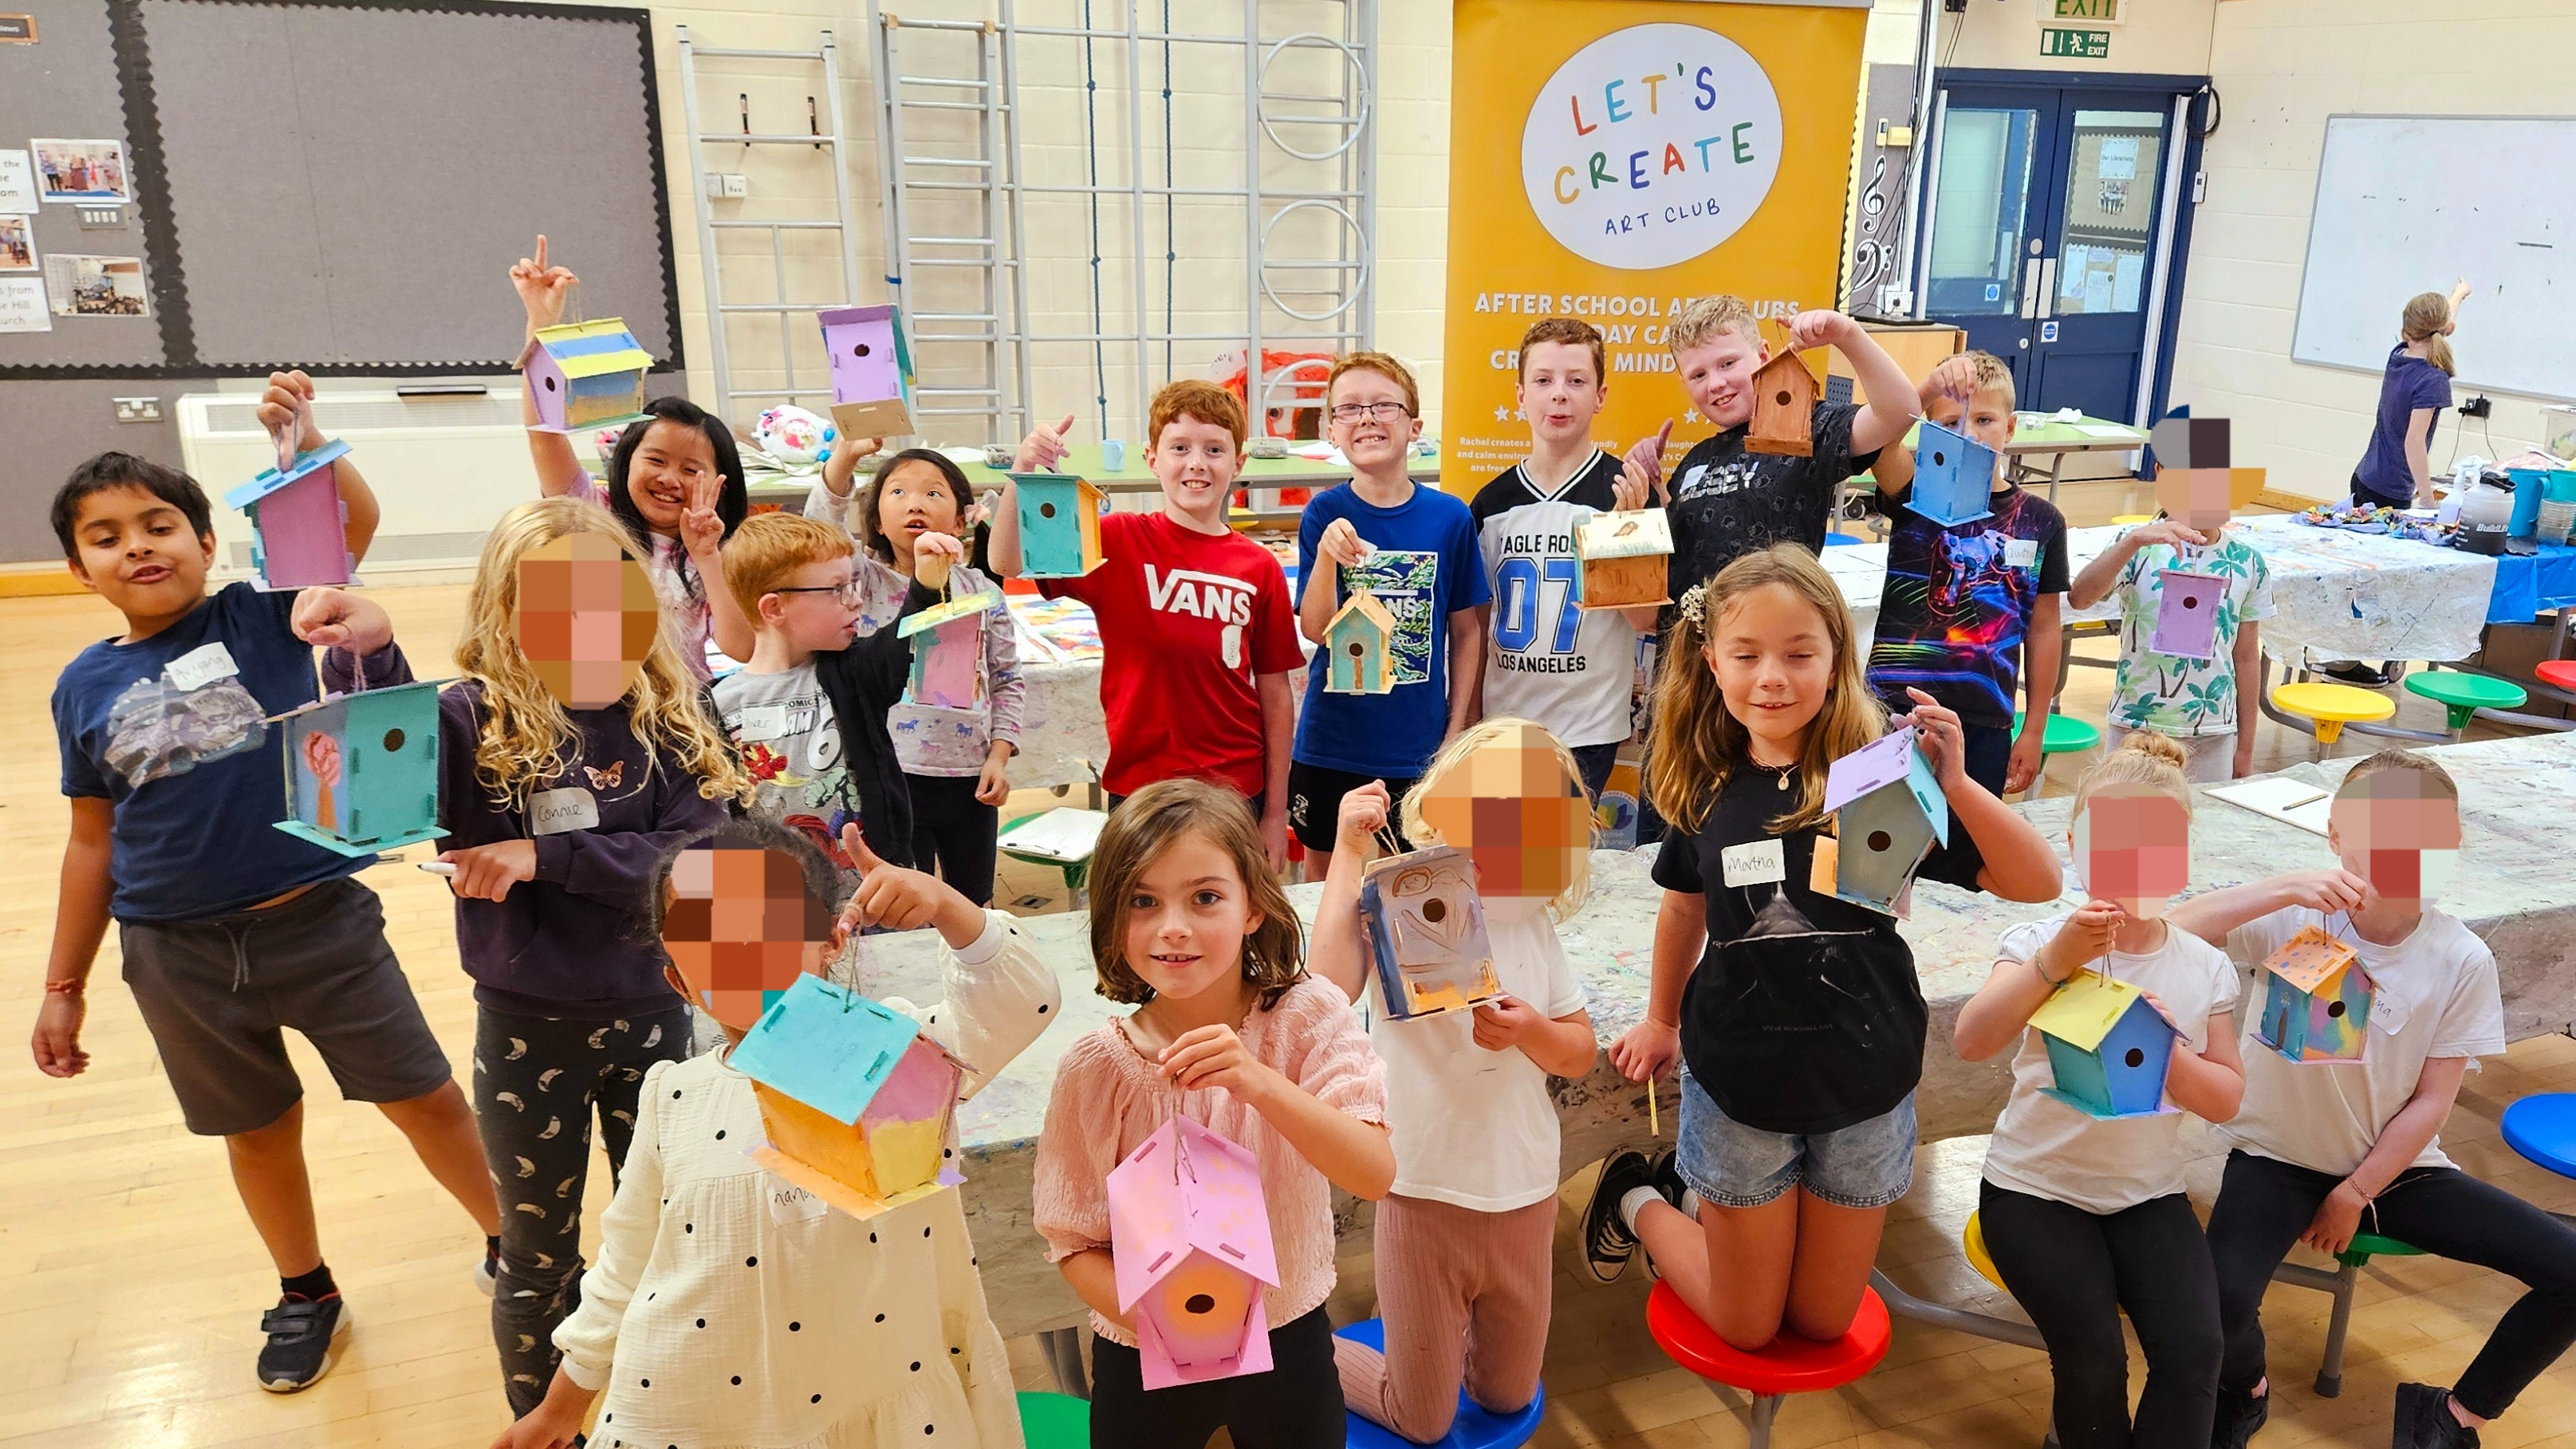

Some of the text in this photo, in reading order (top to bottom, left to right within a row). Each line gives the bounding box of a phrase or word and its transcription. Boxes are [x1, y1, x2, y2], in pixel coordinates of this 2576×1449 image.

[2089, 33, 2108, 43] FIRE
[2087, 45, 2105, 56] EXIT
[1571, 62, 1716, 136] LET'S
[1554, 122, 1755, 204] CREATE
[1605, 198, 1720, 235] ART CLUB
[8, 285, 34, 297] from
[1475, 293, 1553, 314] AFTER
[1560, 295, 1660, 317] SCHOOL
[1459, 437, 1490, 446] Rachel
[1456, 450, 1474, 459] and
[1475, 451, 1496, 459] calm
[1487, 464, 1506, 474] free
[1500, 534, 1542, 554] AGLE
[1144, 563, 1258, 626] VANS
[1493, 557, 1583, 655] 07
[1495, 653, 1585, 674] LOS ANGELES
[538, 800, 584, 822] Connie
[1728, 856, 1776, 873] Martha
